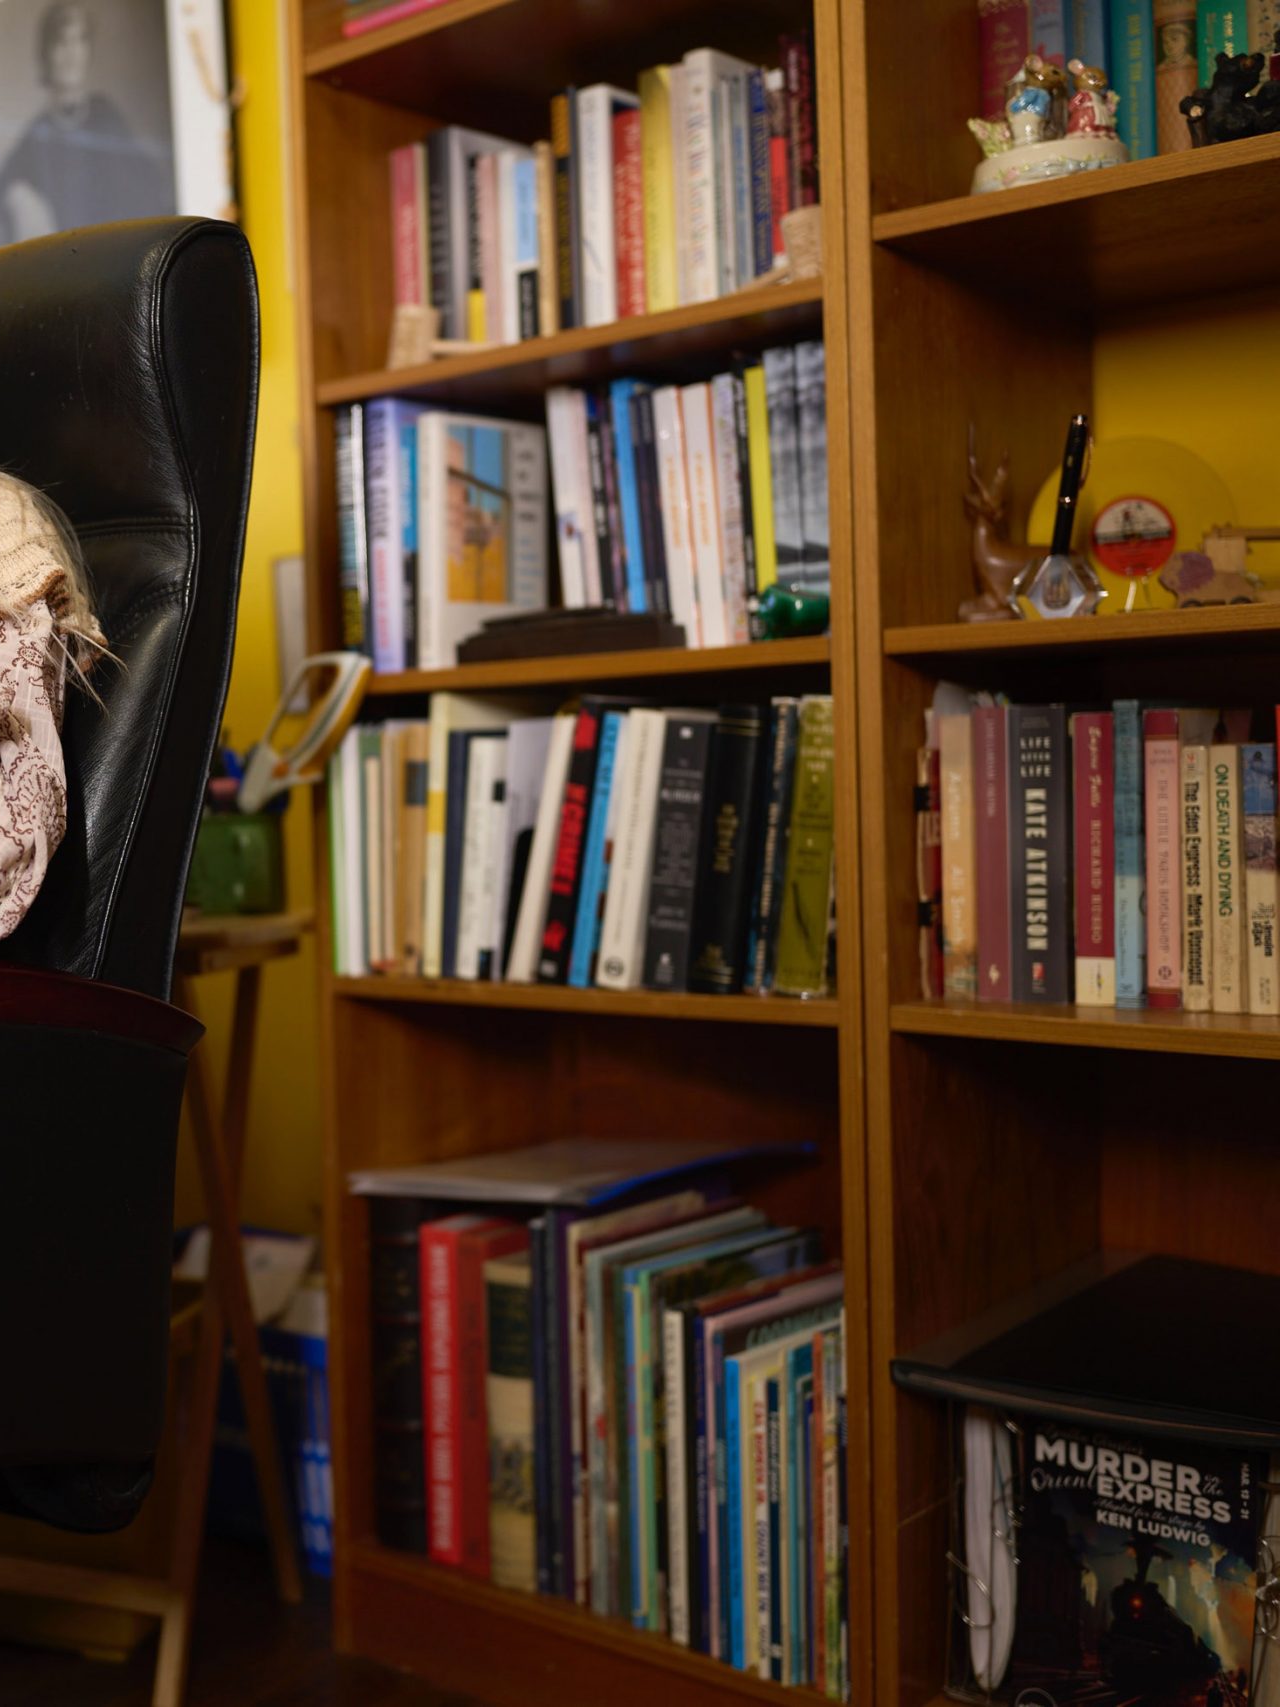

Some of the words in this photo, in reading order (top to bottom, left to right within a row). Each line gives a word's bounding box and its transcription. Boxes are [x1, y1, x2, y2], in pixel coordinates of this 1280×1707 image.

[1020, 737, 1051, 748] LIFE
[1021, 753, 1051, 763] AFTER
[1020, 765, 1052, 778] LIFE
[1185, 782, 1200, 803] The
[1215, 764, 1230, 786] ON
[948, 771, 963, 841] Autumn
[1025, 788, 1047, 839] KATE
[1185, 805, 1201, 835] Eden
[1216, 789, 1231, 836] DEATH
[1090, 819, 1102, 889] RICHARD
[1185, 837, 1202, 888] Express
[1217, 838, 1232, 871] AND
[951, 864, 964, 890] Ali
[1026, 848, 1048, 950] ATKINSON
[1218, 873, 1233, 917] DYING
[951, 896, 965, 946] Smith
[1090, 894, 1102, 944] RUSSO
[1187, 894, 1203, 928] Mark
[1035, 1435, 1202, 1496] MURDER
[1030, 1461, 1098, 1492] Orient
[1097, 1475, 1231, 1524] EXPRESS
[1096, 1509, 1134, 1531] KEN
[1136, 1518, 1212, 1548] LUDWIG
